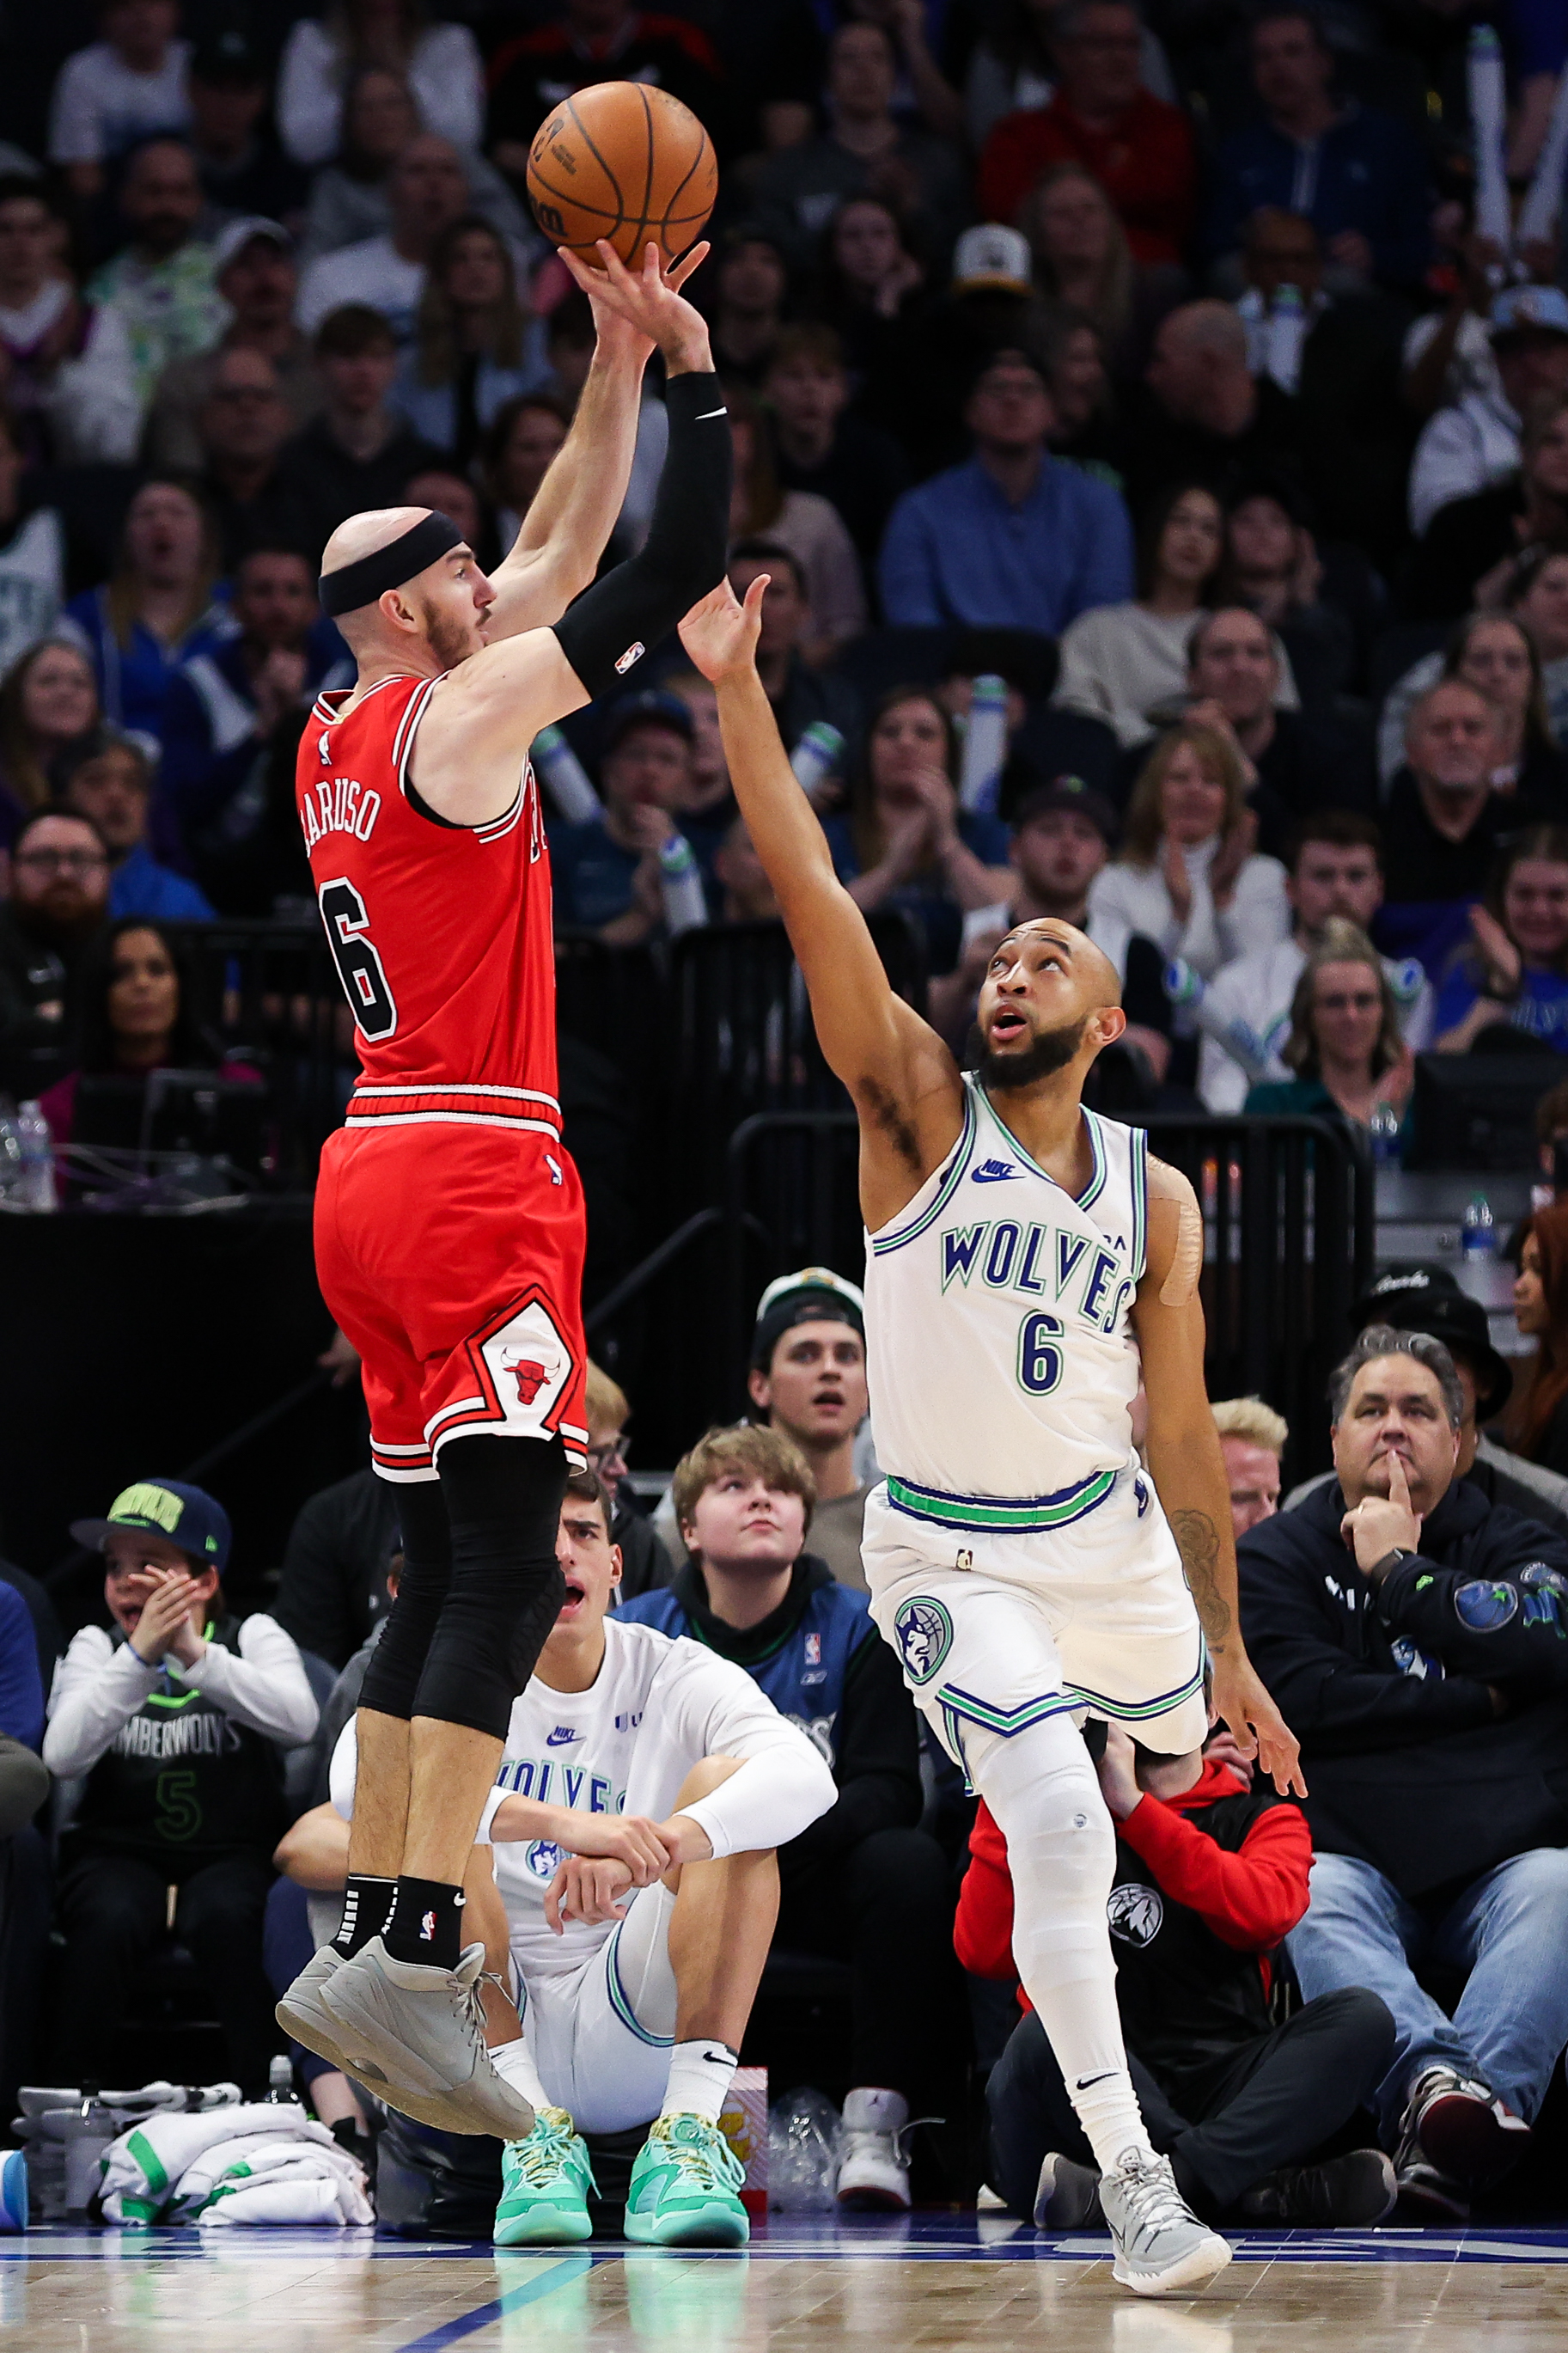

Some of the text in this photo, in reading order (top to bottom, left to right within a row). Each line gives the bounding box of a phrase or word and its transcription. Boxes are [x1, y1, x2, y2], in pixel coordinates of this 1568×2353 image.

[300, 778, 382, 859] ARUSO
[319, 876, 399, 1043] 6
[1016, 1308, 1065, 1397] 6
[154, 1770, 203, 1843] 5
